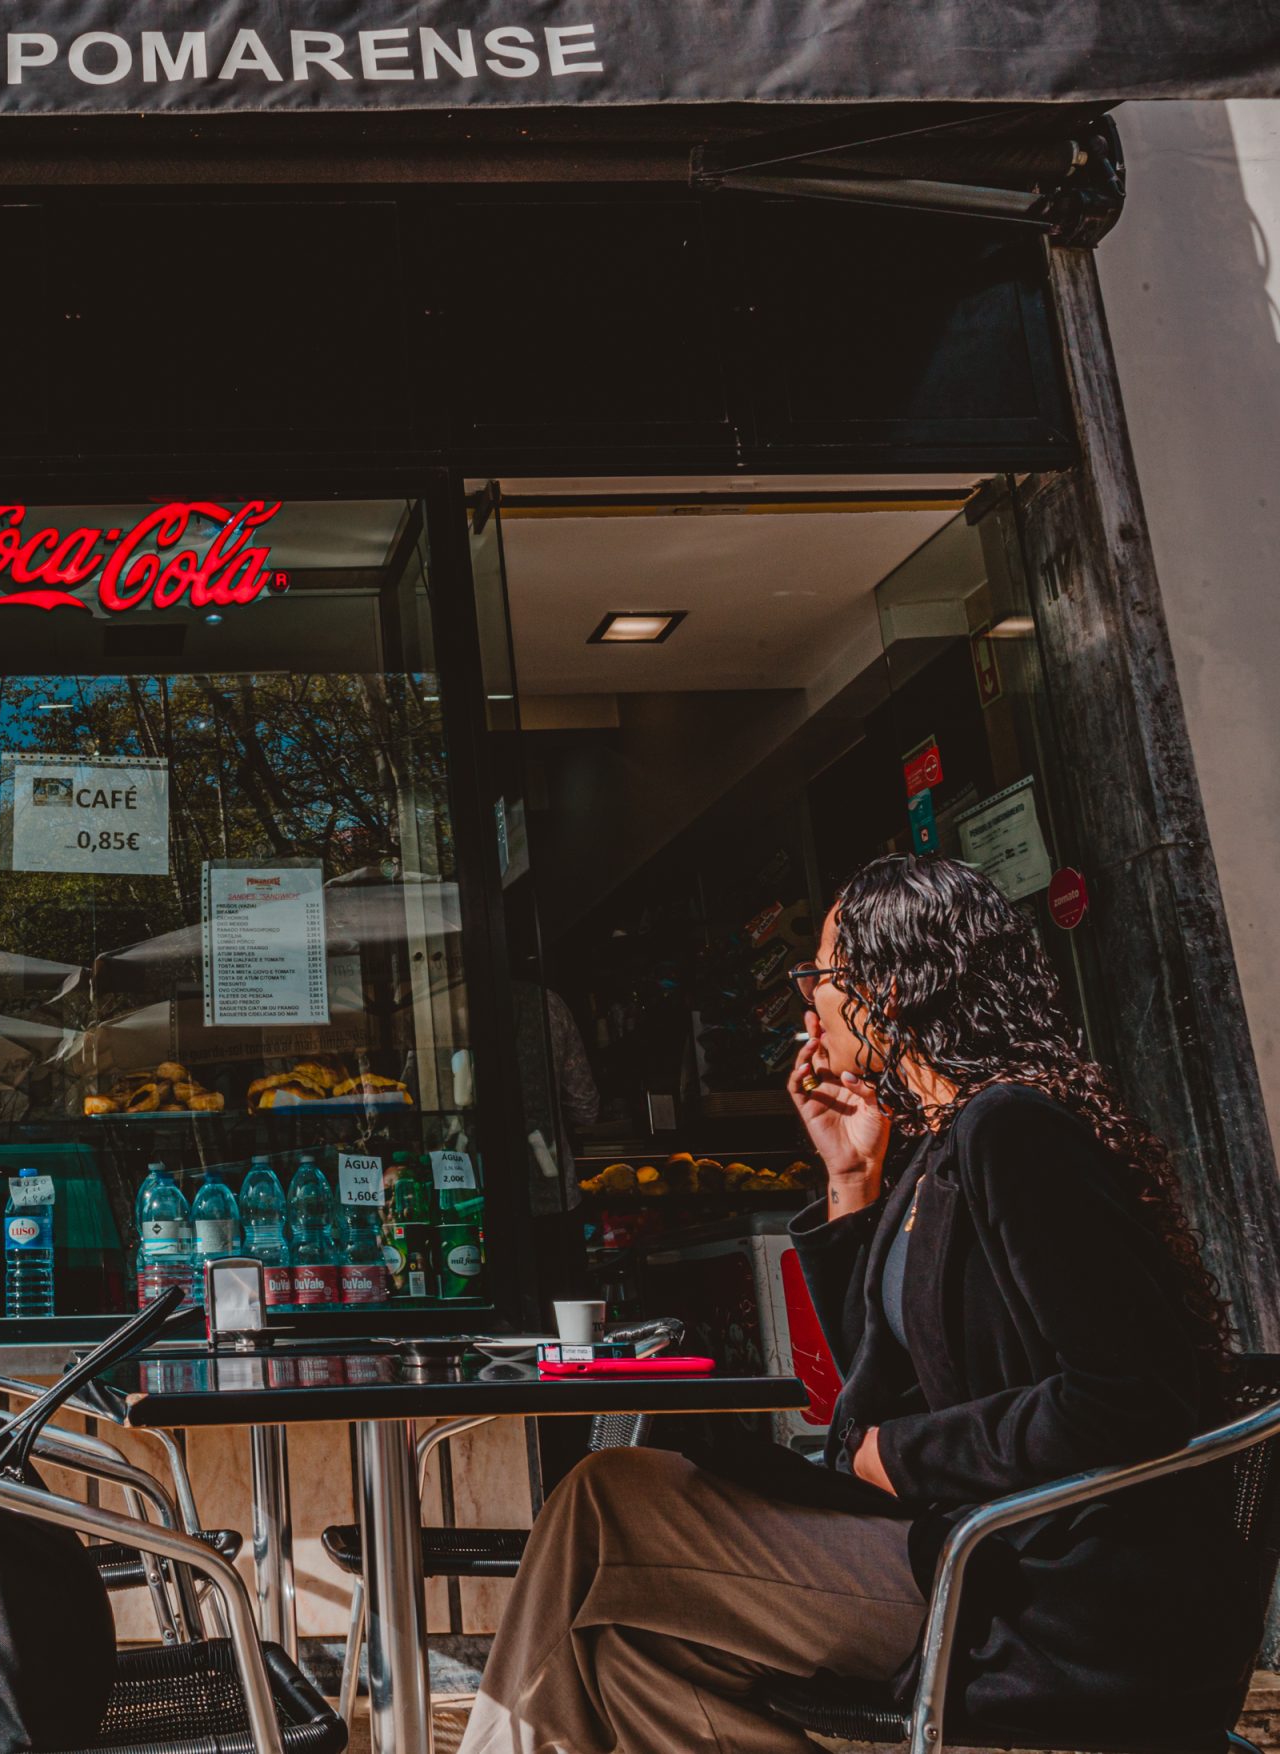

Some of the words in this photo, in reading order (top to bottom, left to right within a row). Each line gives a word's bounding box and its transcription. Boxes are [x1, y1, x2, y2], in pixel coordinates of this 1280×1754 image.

[6, 23, 604, 86] POMARENSE
[75, 785, 138, 810] CAFÉ
[76, 830, 141, 853] 0,85€
[1053, 889, 1080, 908] zomato
[344, 1155, 379, 1170] ÁGUA
[347, 1191, 379, 1203] 1,60€
[11, 1227, 35, 1236] LUSO
[294, 1277, 325, 1291] DuVale
[341, 1277, 373, 1291] DuVale
